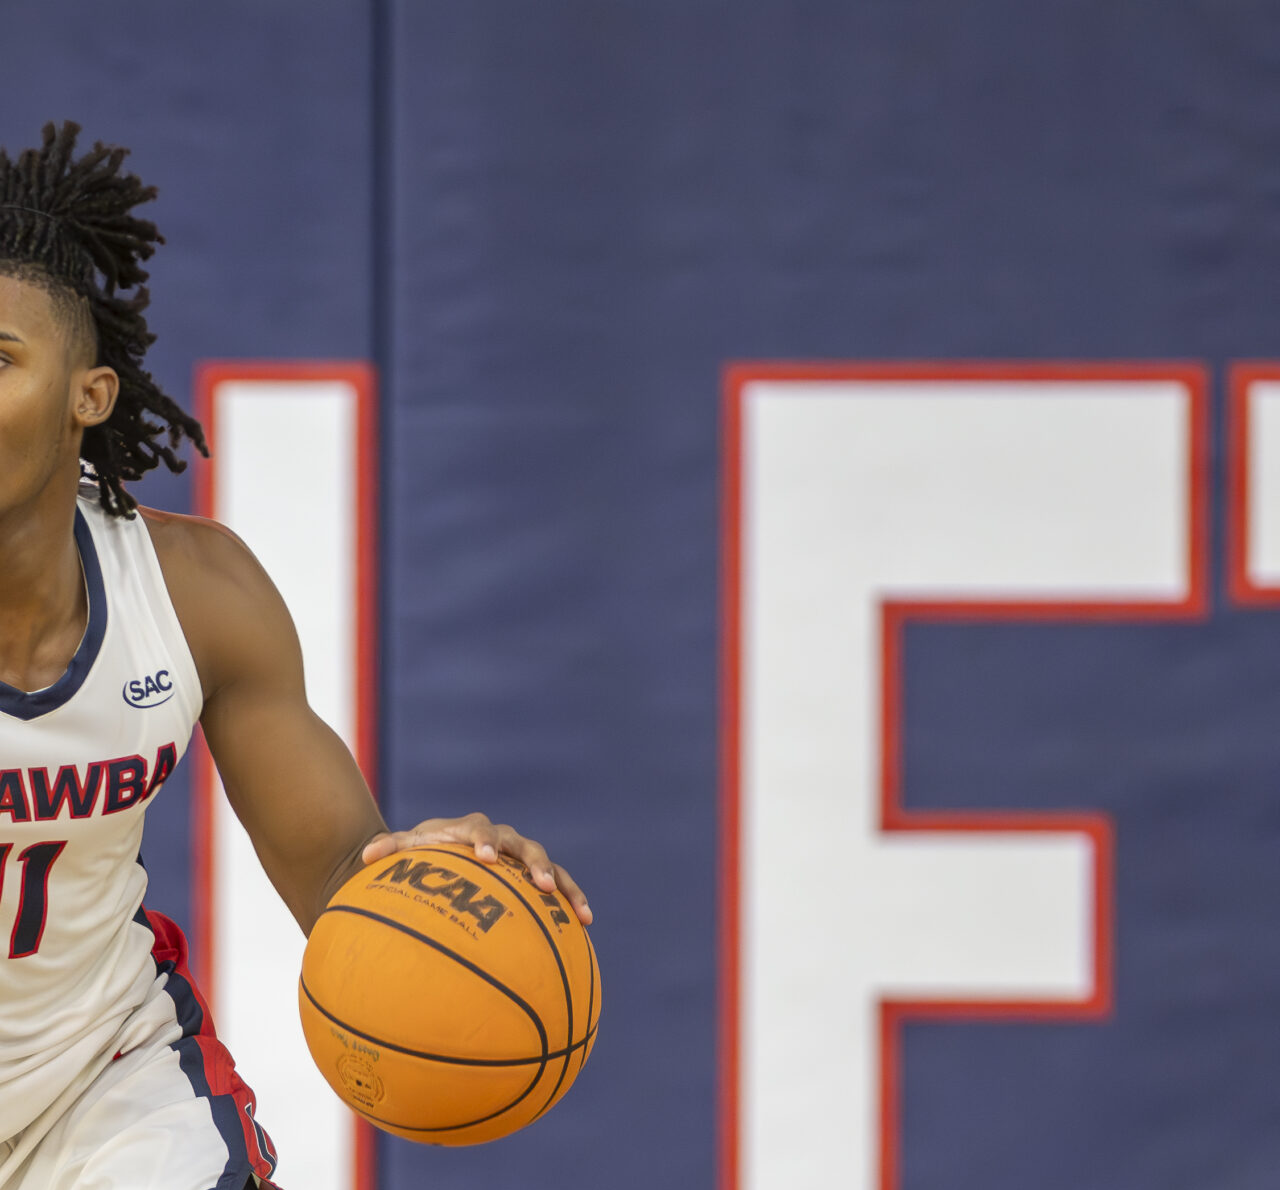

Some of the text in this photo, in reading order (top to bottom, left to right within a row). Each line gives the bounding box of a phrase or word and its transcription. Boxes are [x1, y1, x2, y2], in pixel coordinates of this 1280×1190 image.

[129, 670, 173, 703] SAC
[365, 882, 480, 941] OFFICIAL GAME BALL
[373, 857, 509, 934] NCAA
